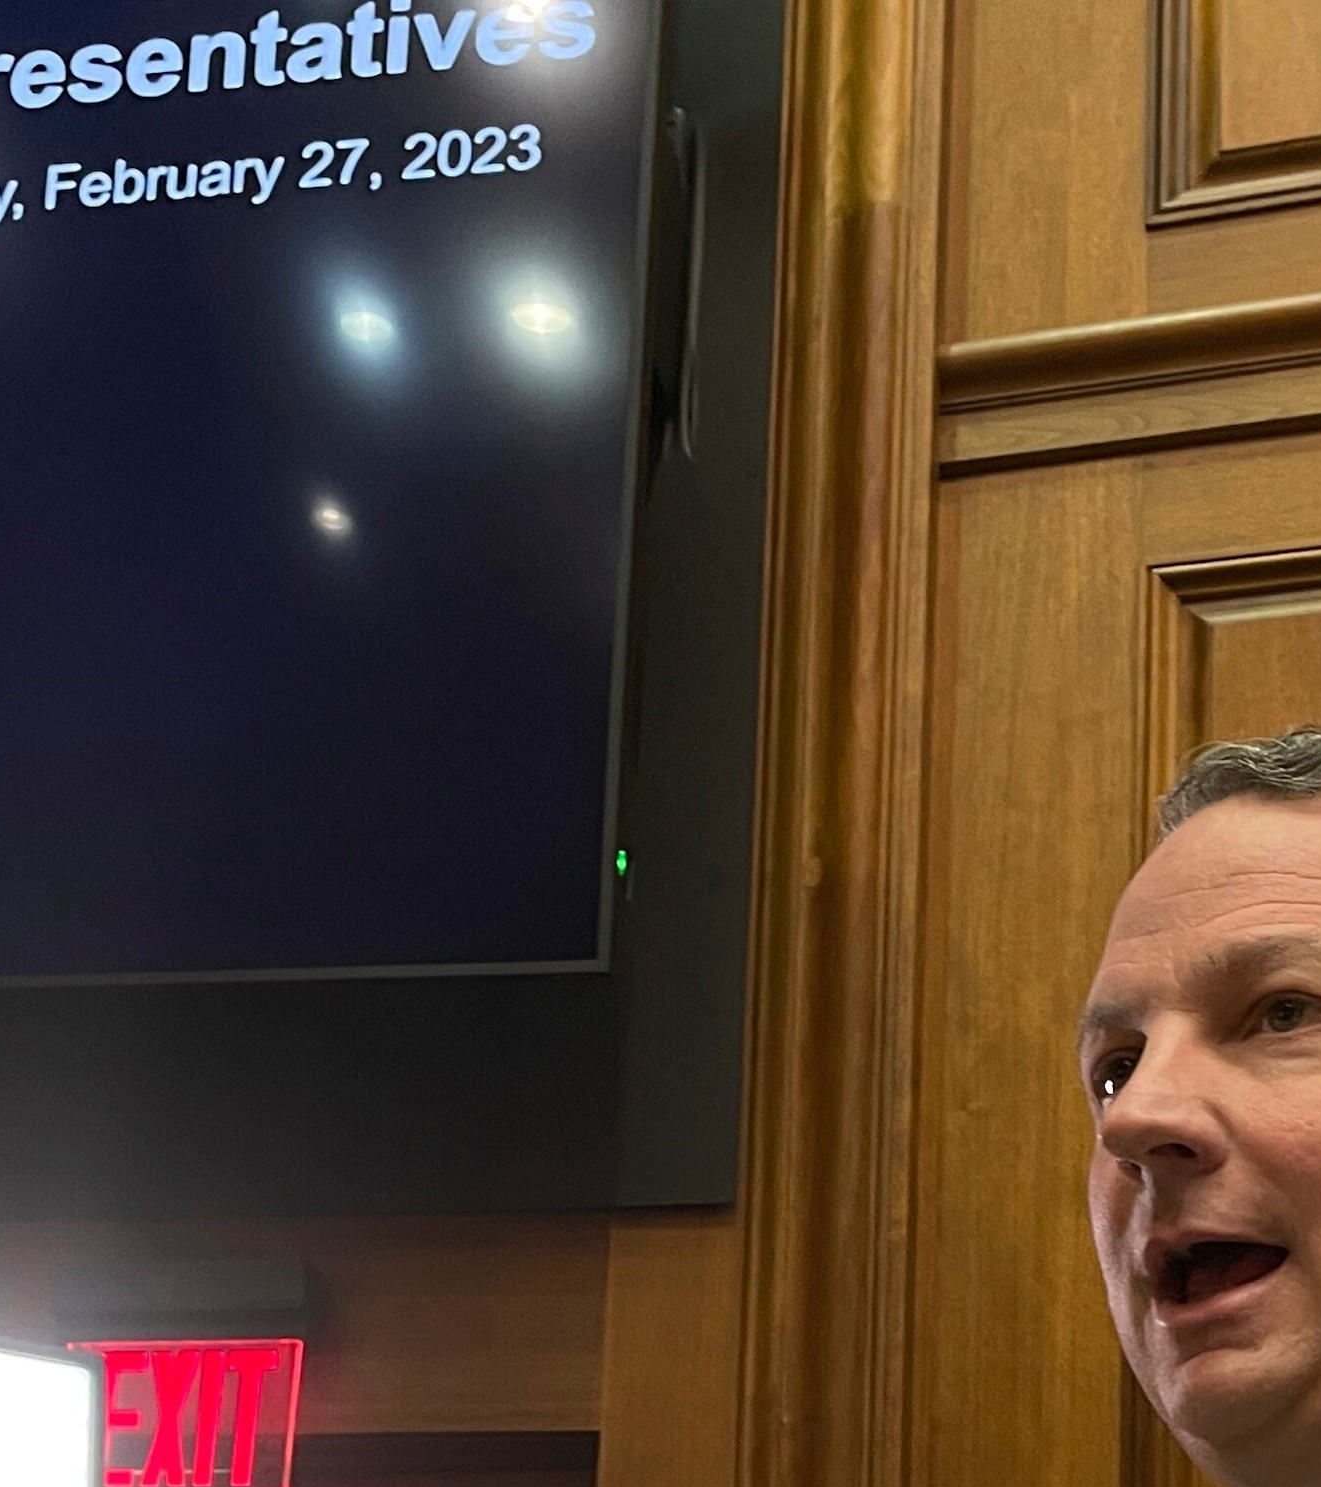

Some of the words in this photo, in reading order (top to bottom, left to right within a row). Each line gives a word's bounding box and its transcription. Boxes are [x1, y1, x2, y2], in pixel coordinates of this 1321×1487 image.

[44, 157, 286, 210] February
[298, 137, 383, 191] 27,
[401, 123, 543, 181] 2023
[103, 1350, 279, 1487] EXIT
